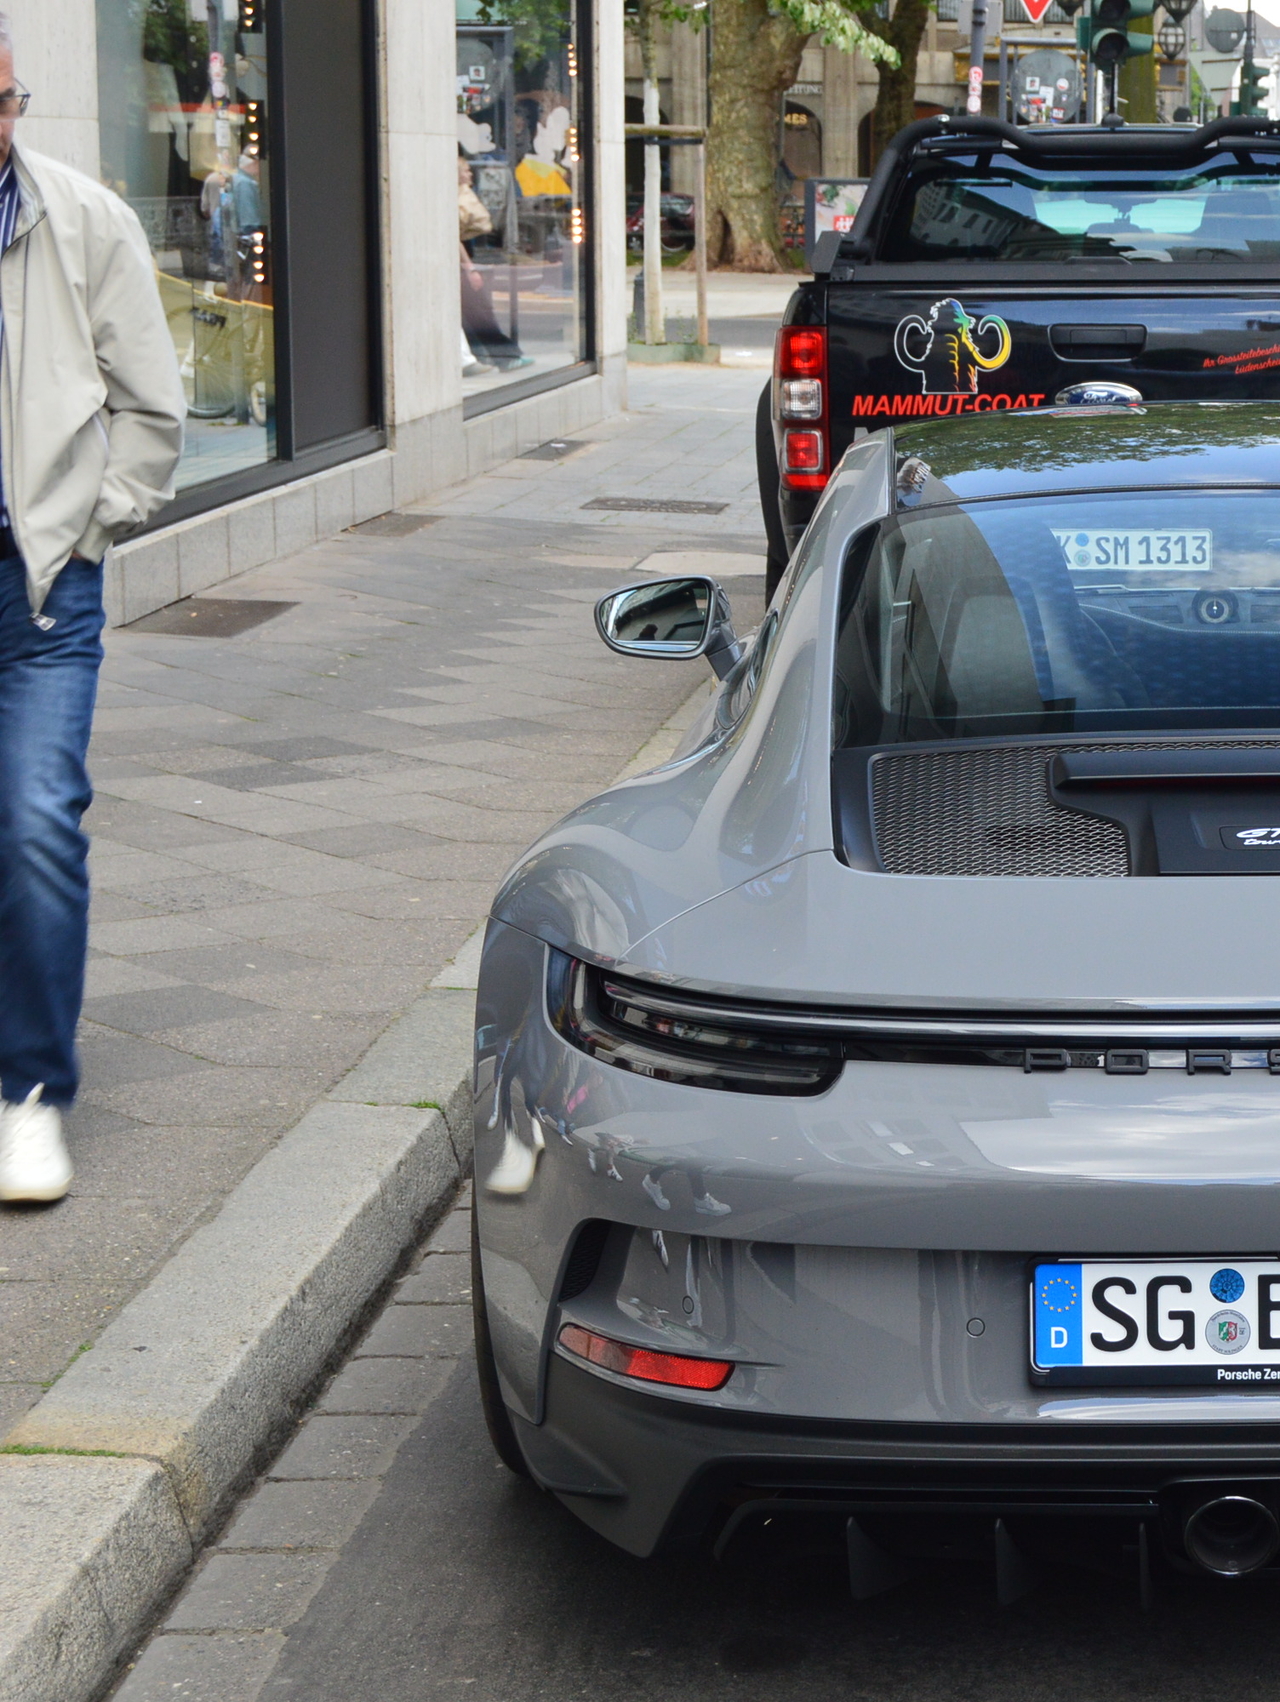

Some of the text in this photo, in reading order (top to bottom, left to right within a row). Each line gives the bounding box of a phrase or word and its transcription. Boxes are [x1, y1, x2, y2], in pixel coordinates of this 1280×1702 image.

[852, 394, 1045, 416] MAMMUT-COAT
[1095, 536, 1130, 565] SM
[1138, 536, 1206, 564] 1313
[1090, 1276, 1195, 1352] SG
[1050, 1327, 1068, 1349] D
[1217, 1369, 1261, 1380] Porsche
